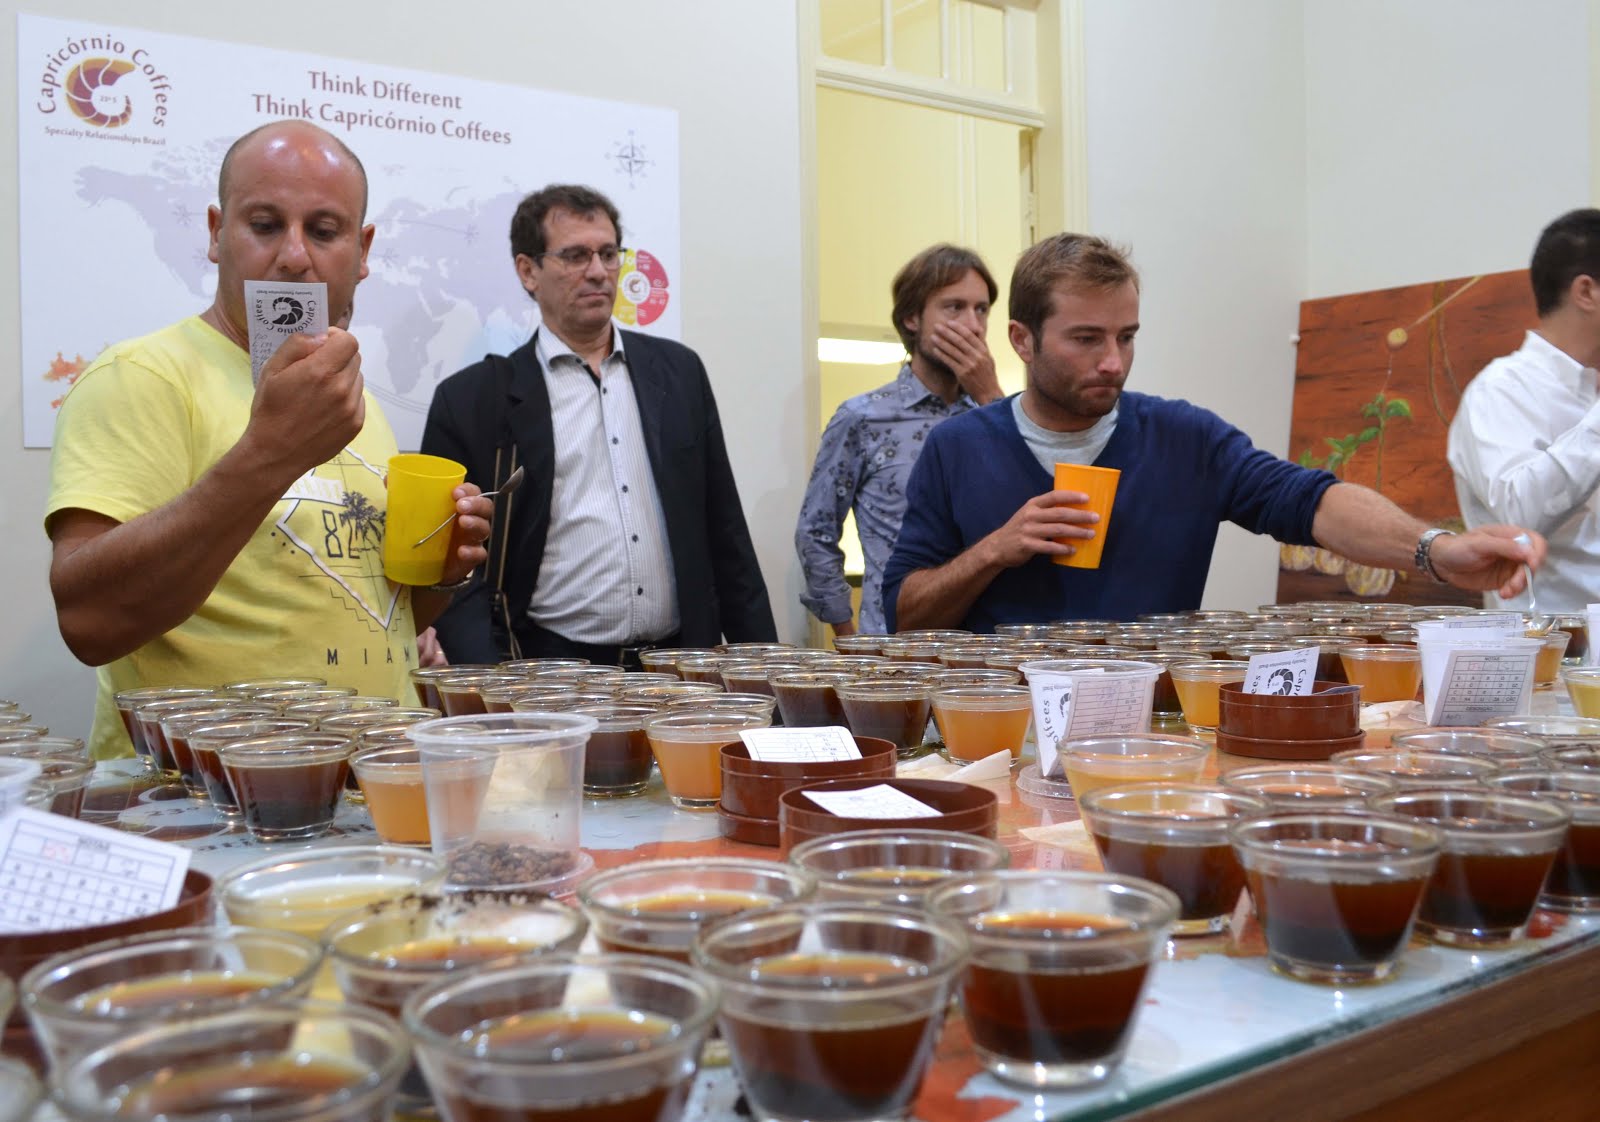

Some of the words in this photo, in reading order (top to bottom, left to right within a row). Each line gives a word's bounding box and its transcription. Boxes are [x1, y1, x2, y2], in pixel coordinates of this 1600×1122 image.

[37, 33, 125, 114] Capricórnio
[131, 48, 172, 127] Coffees
[308, 70, 367, 97] Think
[372, 79, 463, 110] Different
[251, 93, 313, 119] Think
[319, 102, 436, 136] Capricórnio
[441, 119, 512, 145] Coffees
[1043, 699, 1059, 744] offees
